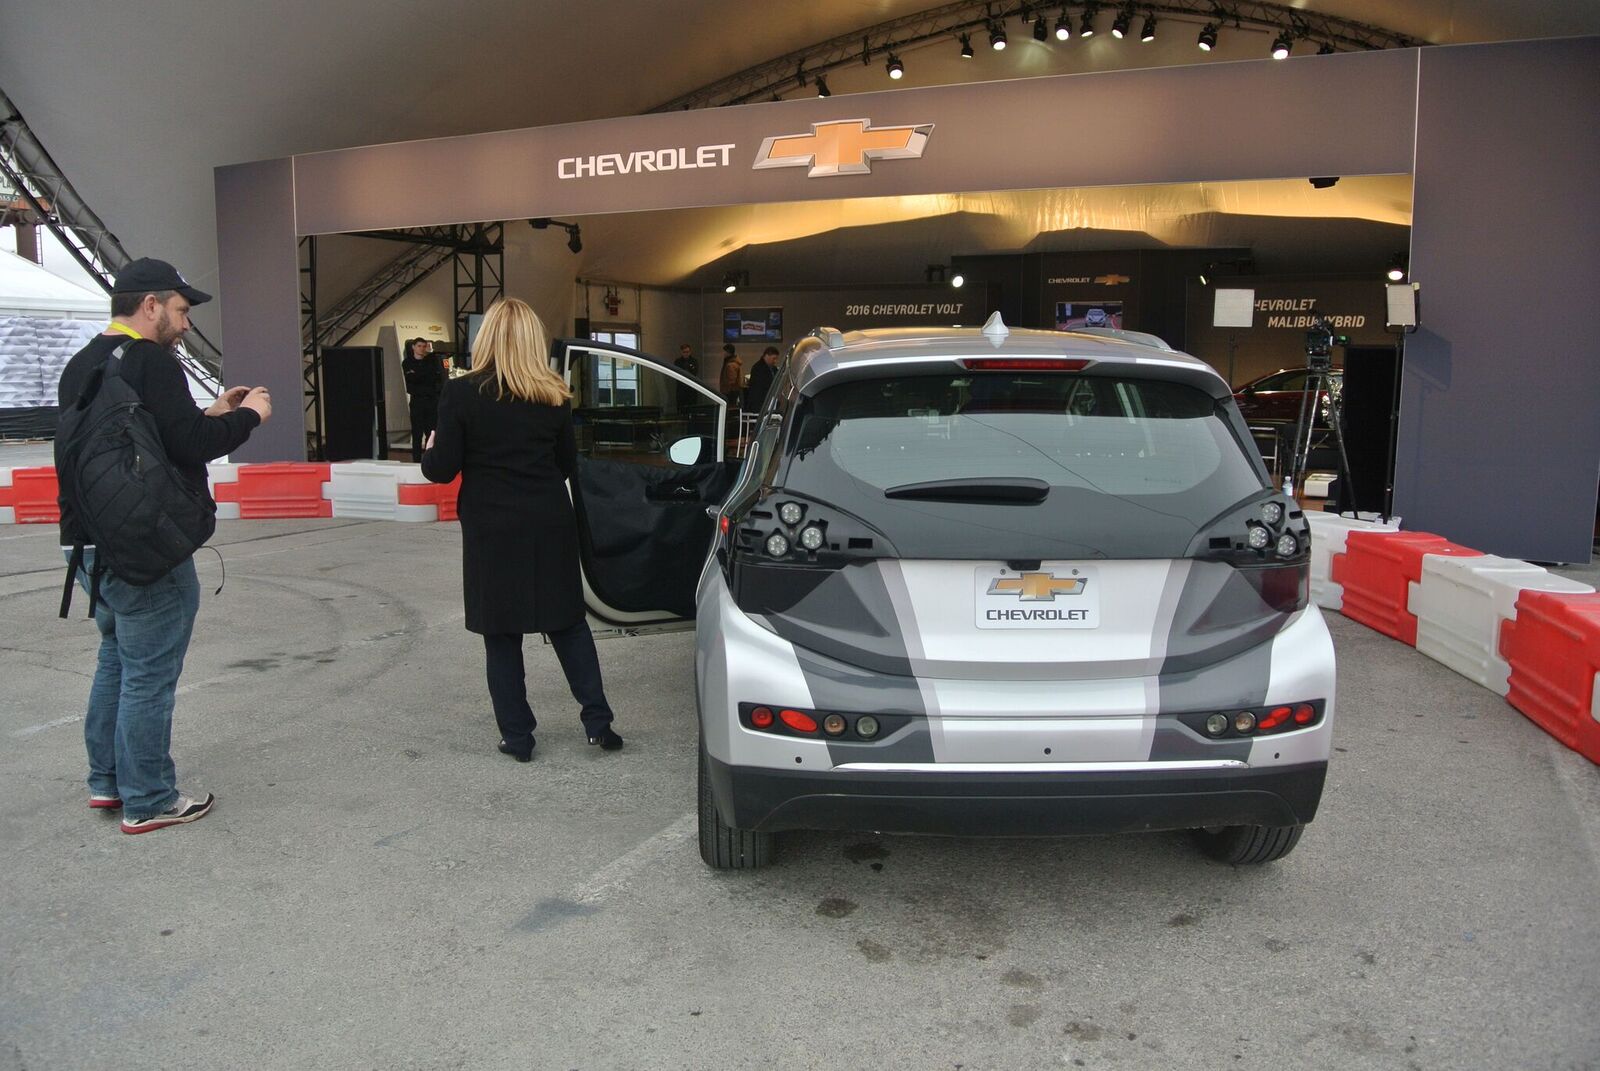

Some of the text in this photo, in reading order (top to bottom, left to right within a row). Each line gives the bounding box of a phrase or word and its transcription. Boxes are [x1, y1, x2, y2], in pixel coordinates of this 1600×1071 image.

[558, 143, 736, 180] CHEVROLET
[1048, 276, 1090, 284] CHEVROLET
[846, 303, 964, 316] 2016 CHEVROLET VOLT
[1253, 298, 1317, 312] HEVROLET
[1267, 315, 1366, 328] MALIBU YBRID
[986, 609, 1090, 621] CHEVROLET
